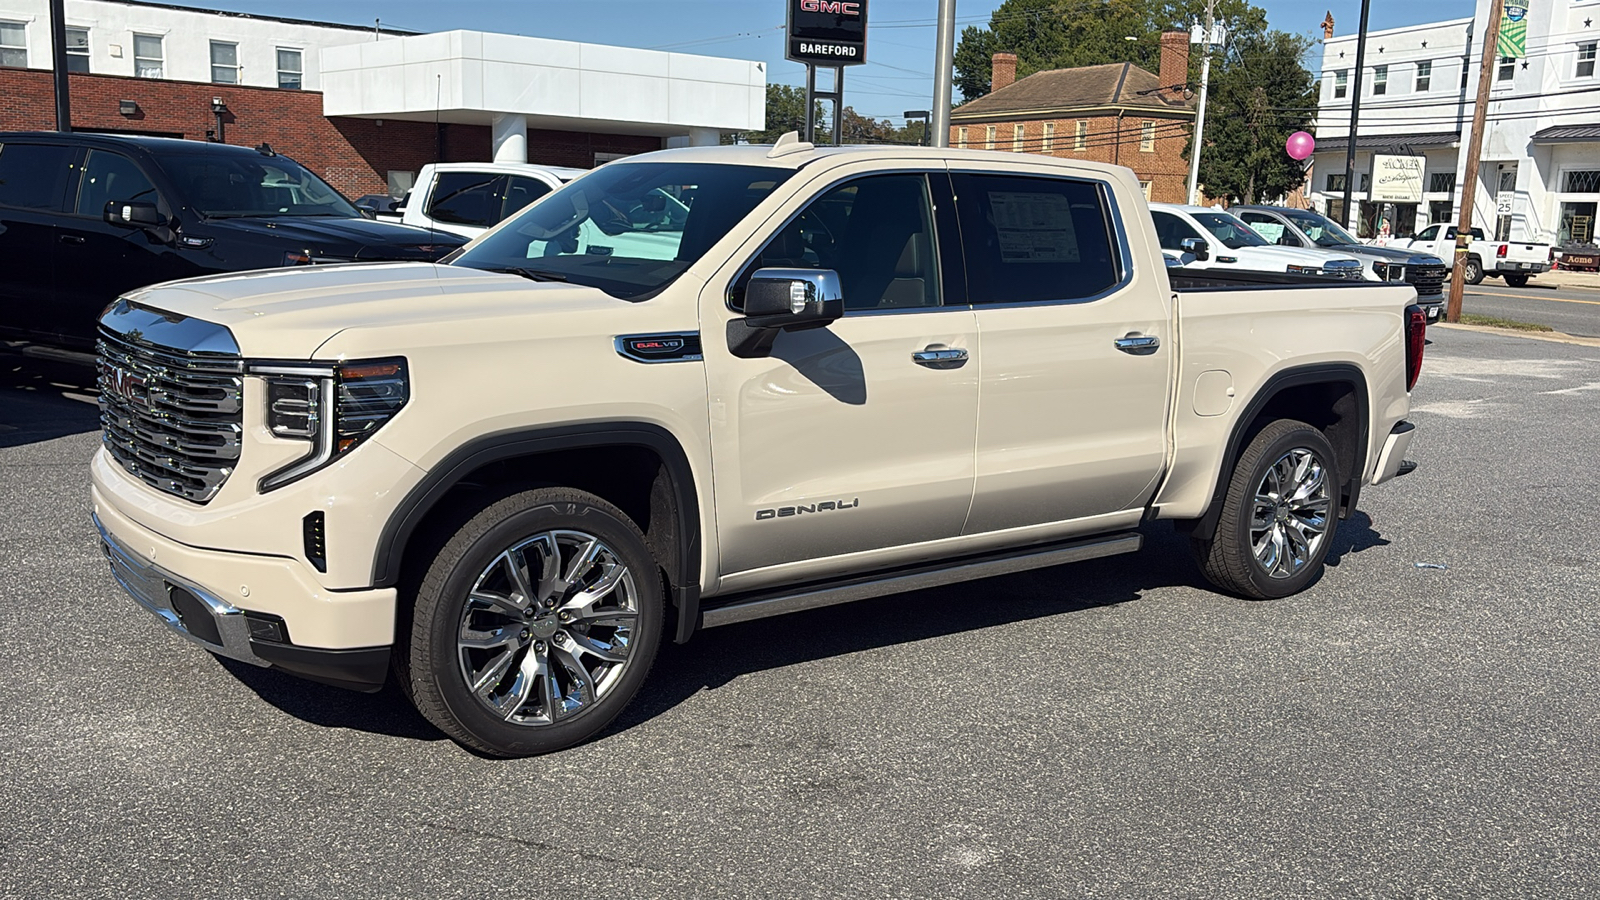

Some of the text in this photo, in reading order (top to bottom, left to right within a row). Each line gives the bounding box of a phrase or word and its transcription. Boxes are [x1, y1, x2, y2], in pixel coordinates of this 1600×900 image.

[801, 0, 860, 15] GMC
[800, 43, 856, 56] BAREFORD
[1498, 203, 1511, 212] 25
[1567, 255, 1593, 264] Acme
[755, 498, 859, 520] DENALI
